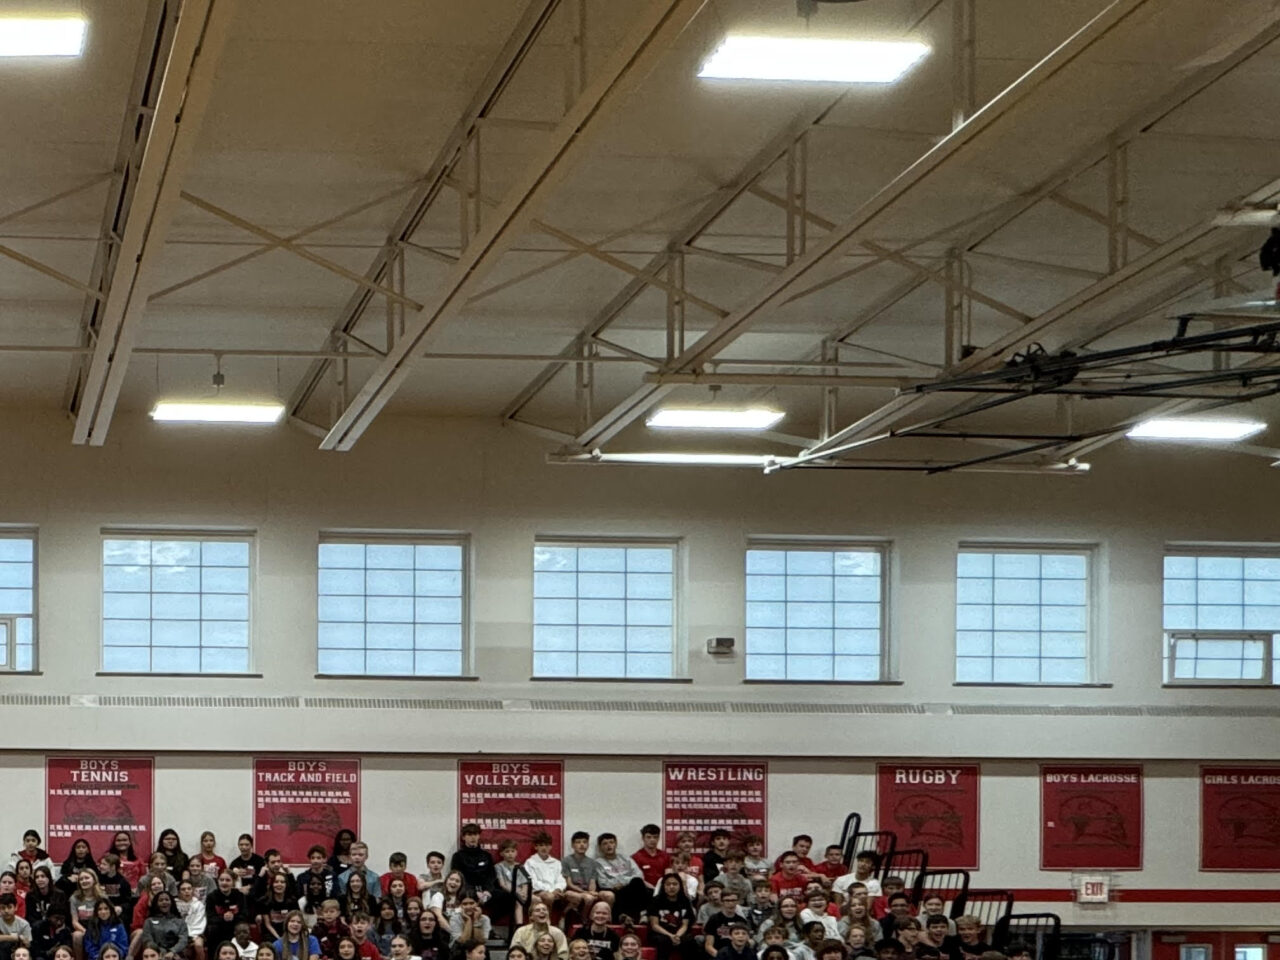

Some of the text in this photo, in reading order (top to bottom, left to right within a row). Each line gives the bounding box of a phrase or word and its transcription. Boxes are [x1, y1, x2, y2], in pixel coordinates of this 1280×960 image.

[80, 760, 119, 770] BOYS
[288, 761, 327, 771] BOYS
[492, 763, 530, 773] BOYS
[70, 770, 129, 782] TENNIS
[257, 773, 357, 783] TRACK AND FIELD
[667, 767, 764, 781] WRESTLING
[894, 769, 962, 784] RUGBY
[1046, 774, 1137, 783] BOYS LACROSSE
[464, 774, 558, 786] VOLLEYBALL
[1204, 775, 1238, 785] GIRLS
[1085, 882, 1104, 896] EXIT
